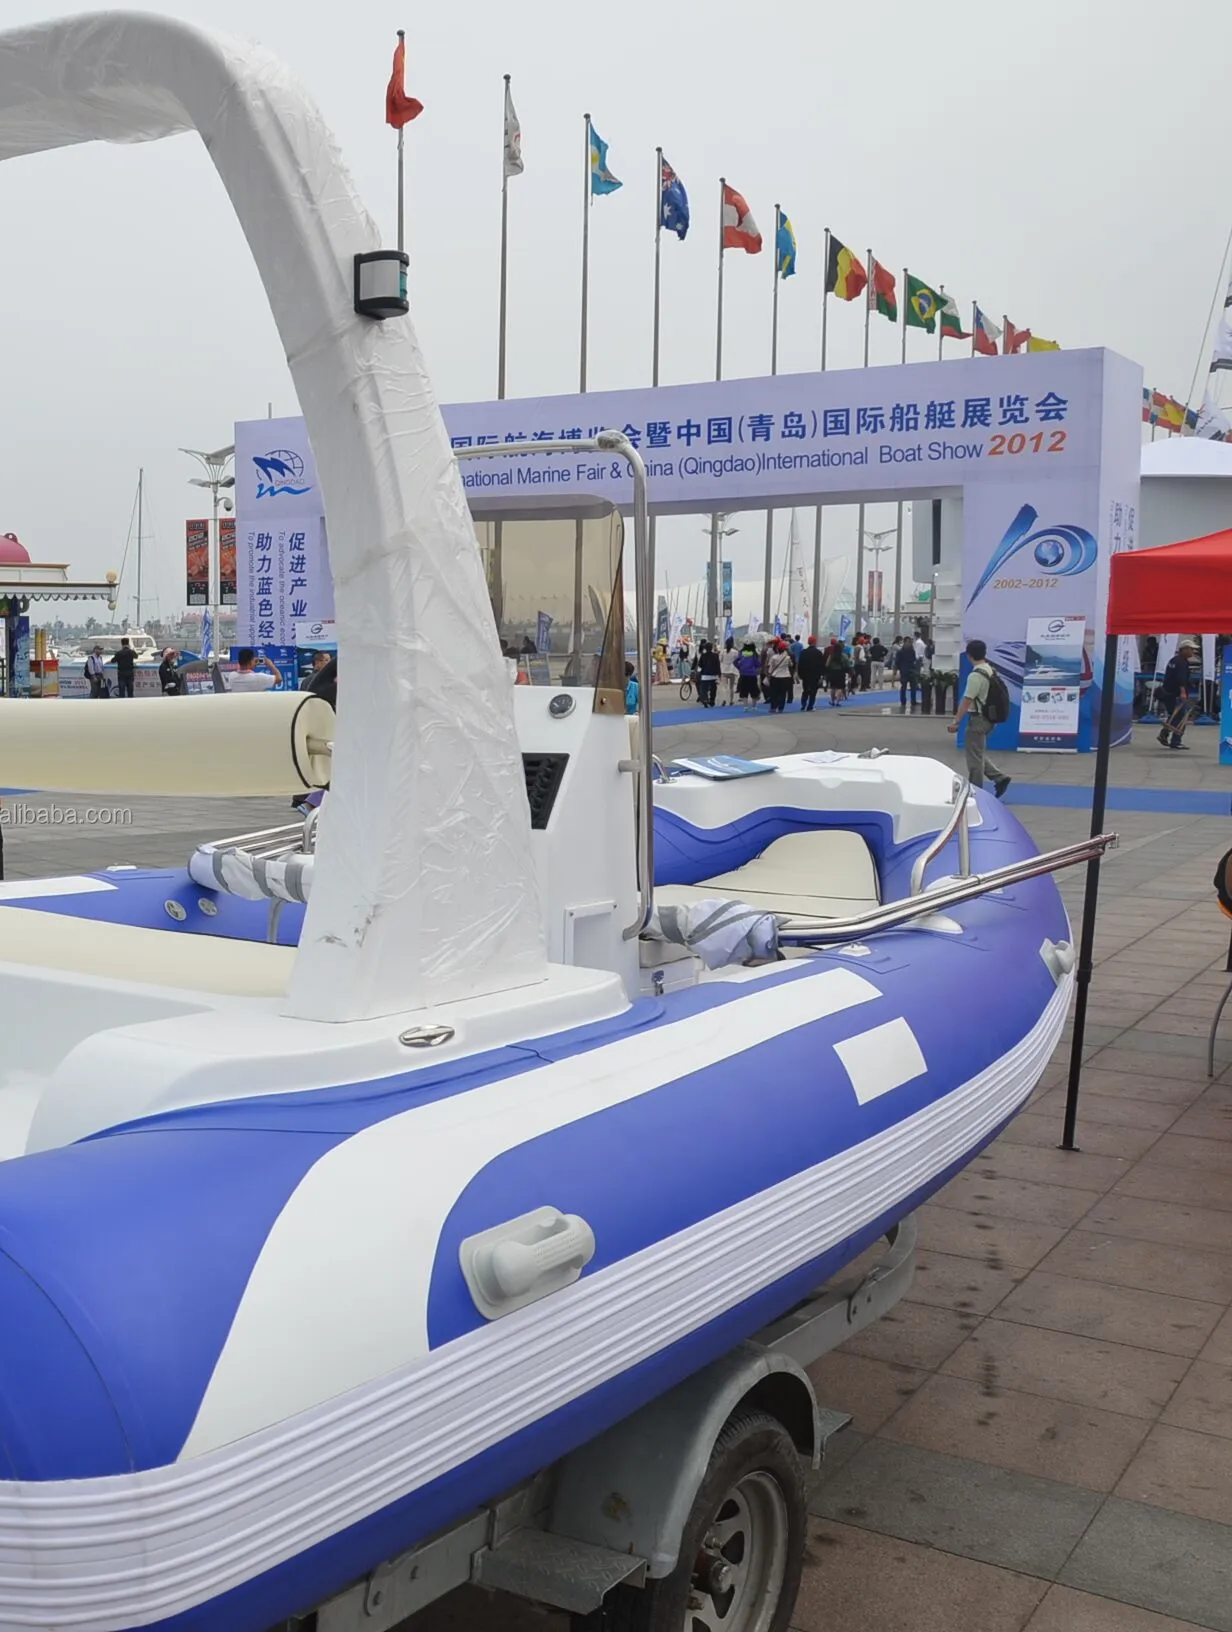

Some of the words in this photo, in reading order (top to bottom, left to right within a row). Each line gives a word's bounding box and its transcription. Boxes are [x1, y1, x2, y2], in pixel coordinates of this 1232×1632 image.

[517, 466, 571, 485] Marine
[576, 462, 607, 481] Fair
[610, 461, 622, 479] &
[879, 444, 923, 464] Boat
[928, 441, 984, 460] Show
[988, 430, 1067, 456] 2012
[256, 532, 275, 646] 助力蓝色经
[289, 532, 307, 640] 促进产业
